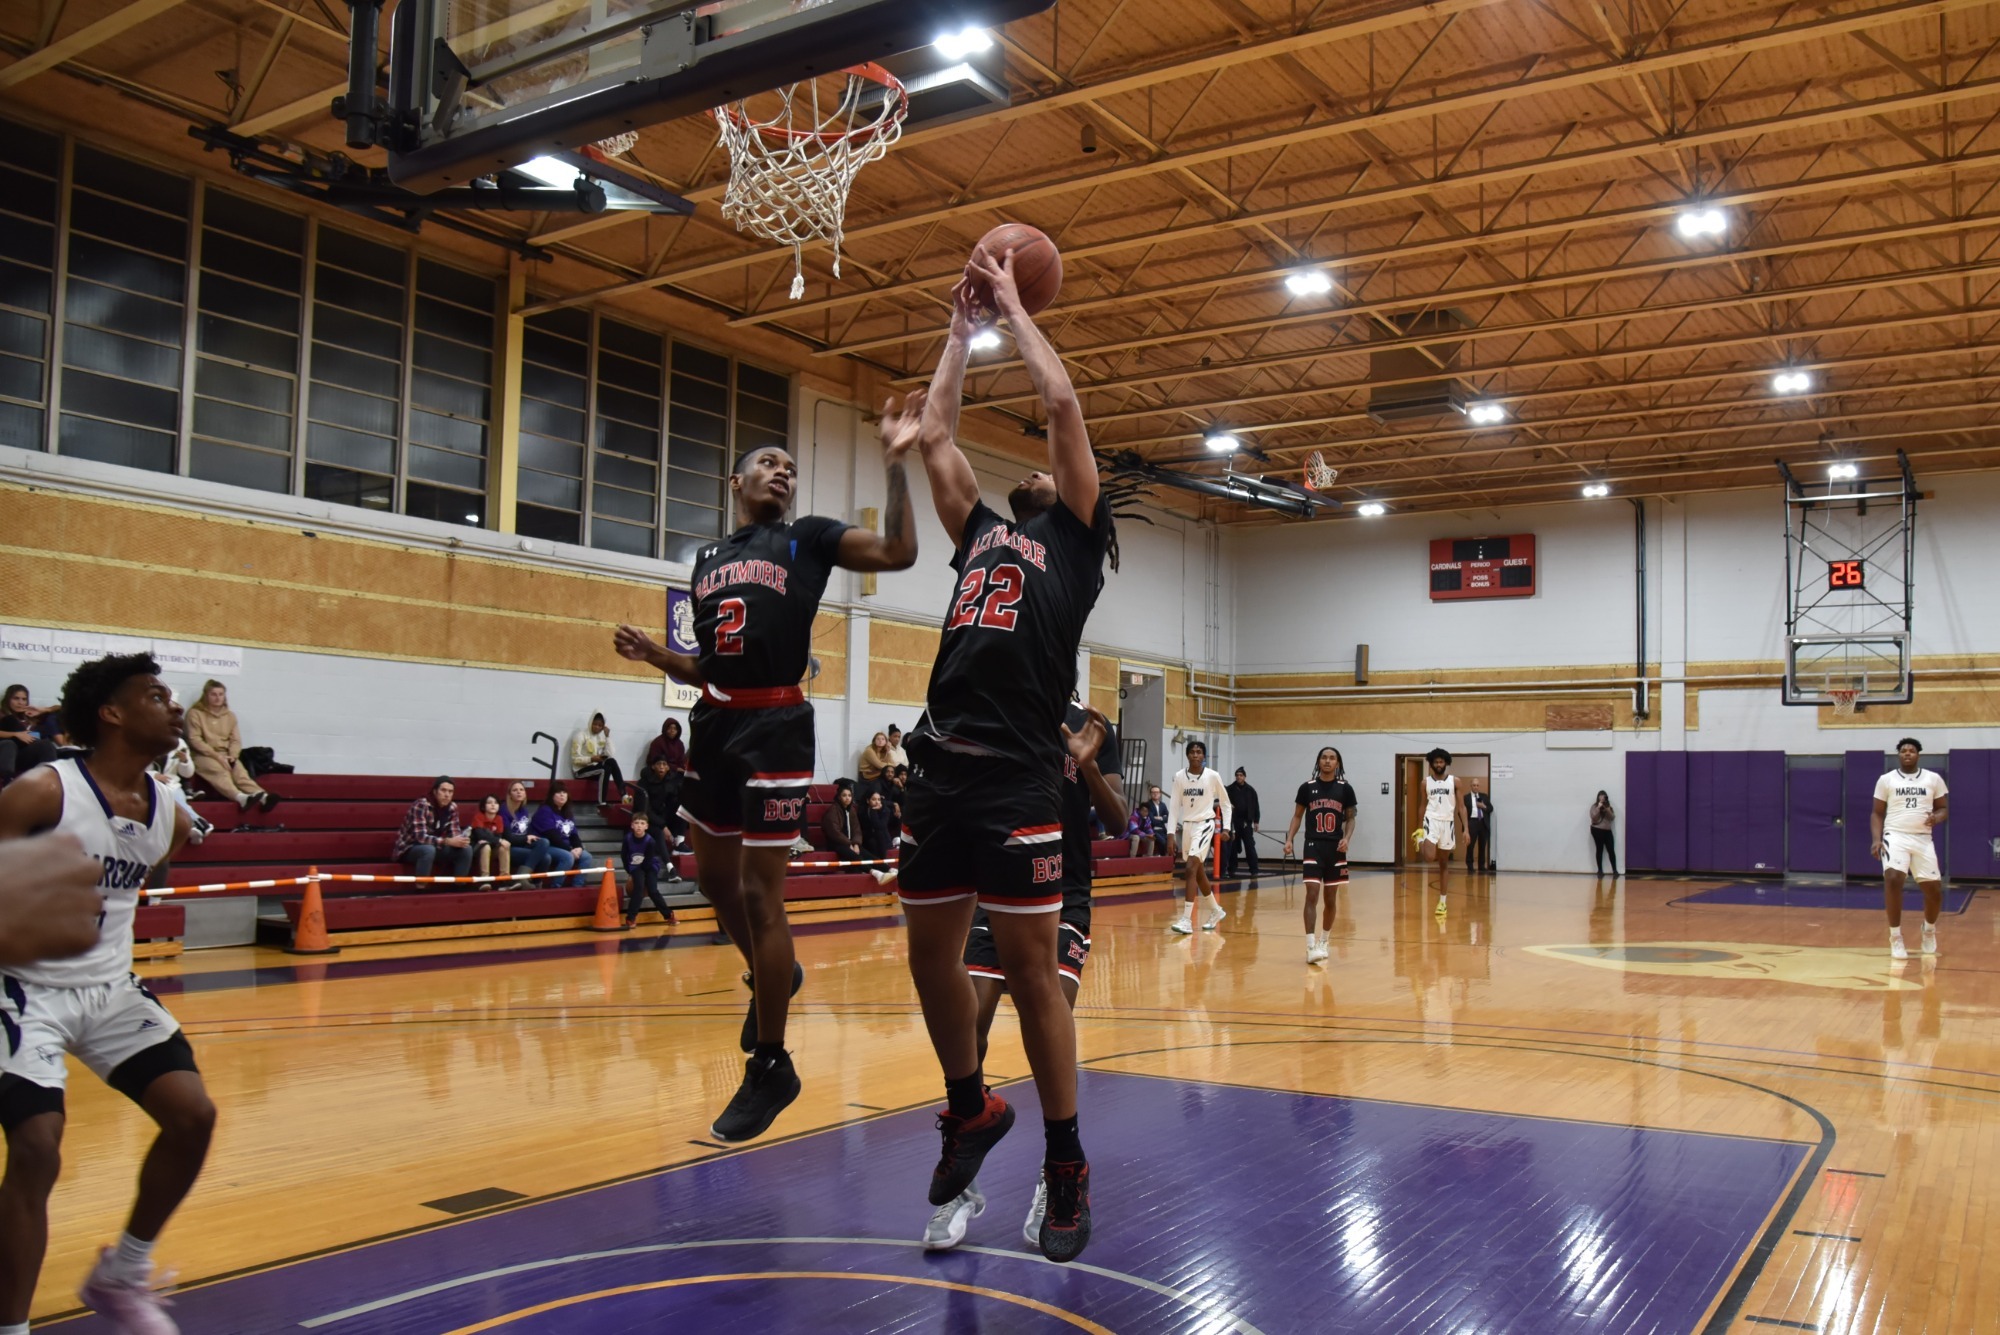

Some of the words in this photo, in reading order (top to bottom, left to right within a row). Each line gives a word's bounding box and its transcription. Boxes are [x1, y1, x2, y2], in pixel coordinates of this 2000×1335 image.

[1431, 562, 1461, 570] CARDINALS
[1503, 558, 1527, 566] GUEST
[1832, 562, 1861, 585] 26
[947, 563, 1025, 632] 22
[715, 597, 747, 656] 2
[0, 641, 51, 653] HARCUM
[54, 645, 101, 657] COLLEGE
[201, 658, 240, 668] SECTION
[676, 689, 699, 701] 1915
[1430, 788, 1450, 796] HARCUM
[1896, 787, 1927, 796] HARCUM
[1905, 797, 1917, 809] 23
[1316, 812, 1336, 833] 10
